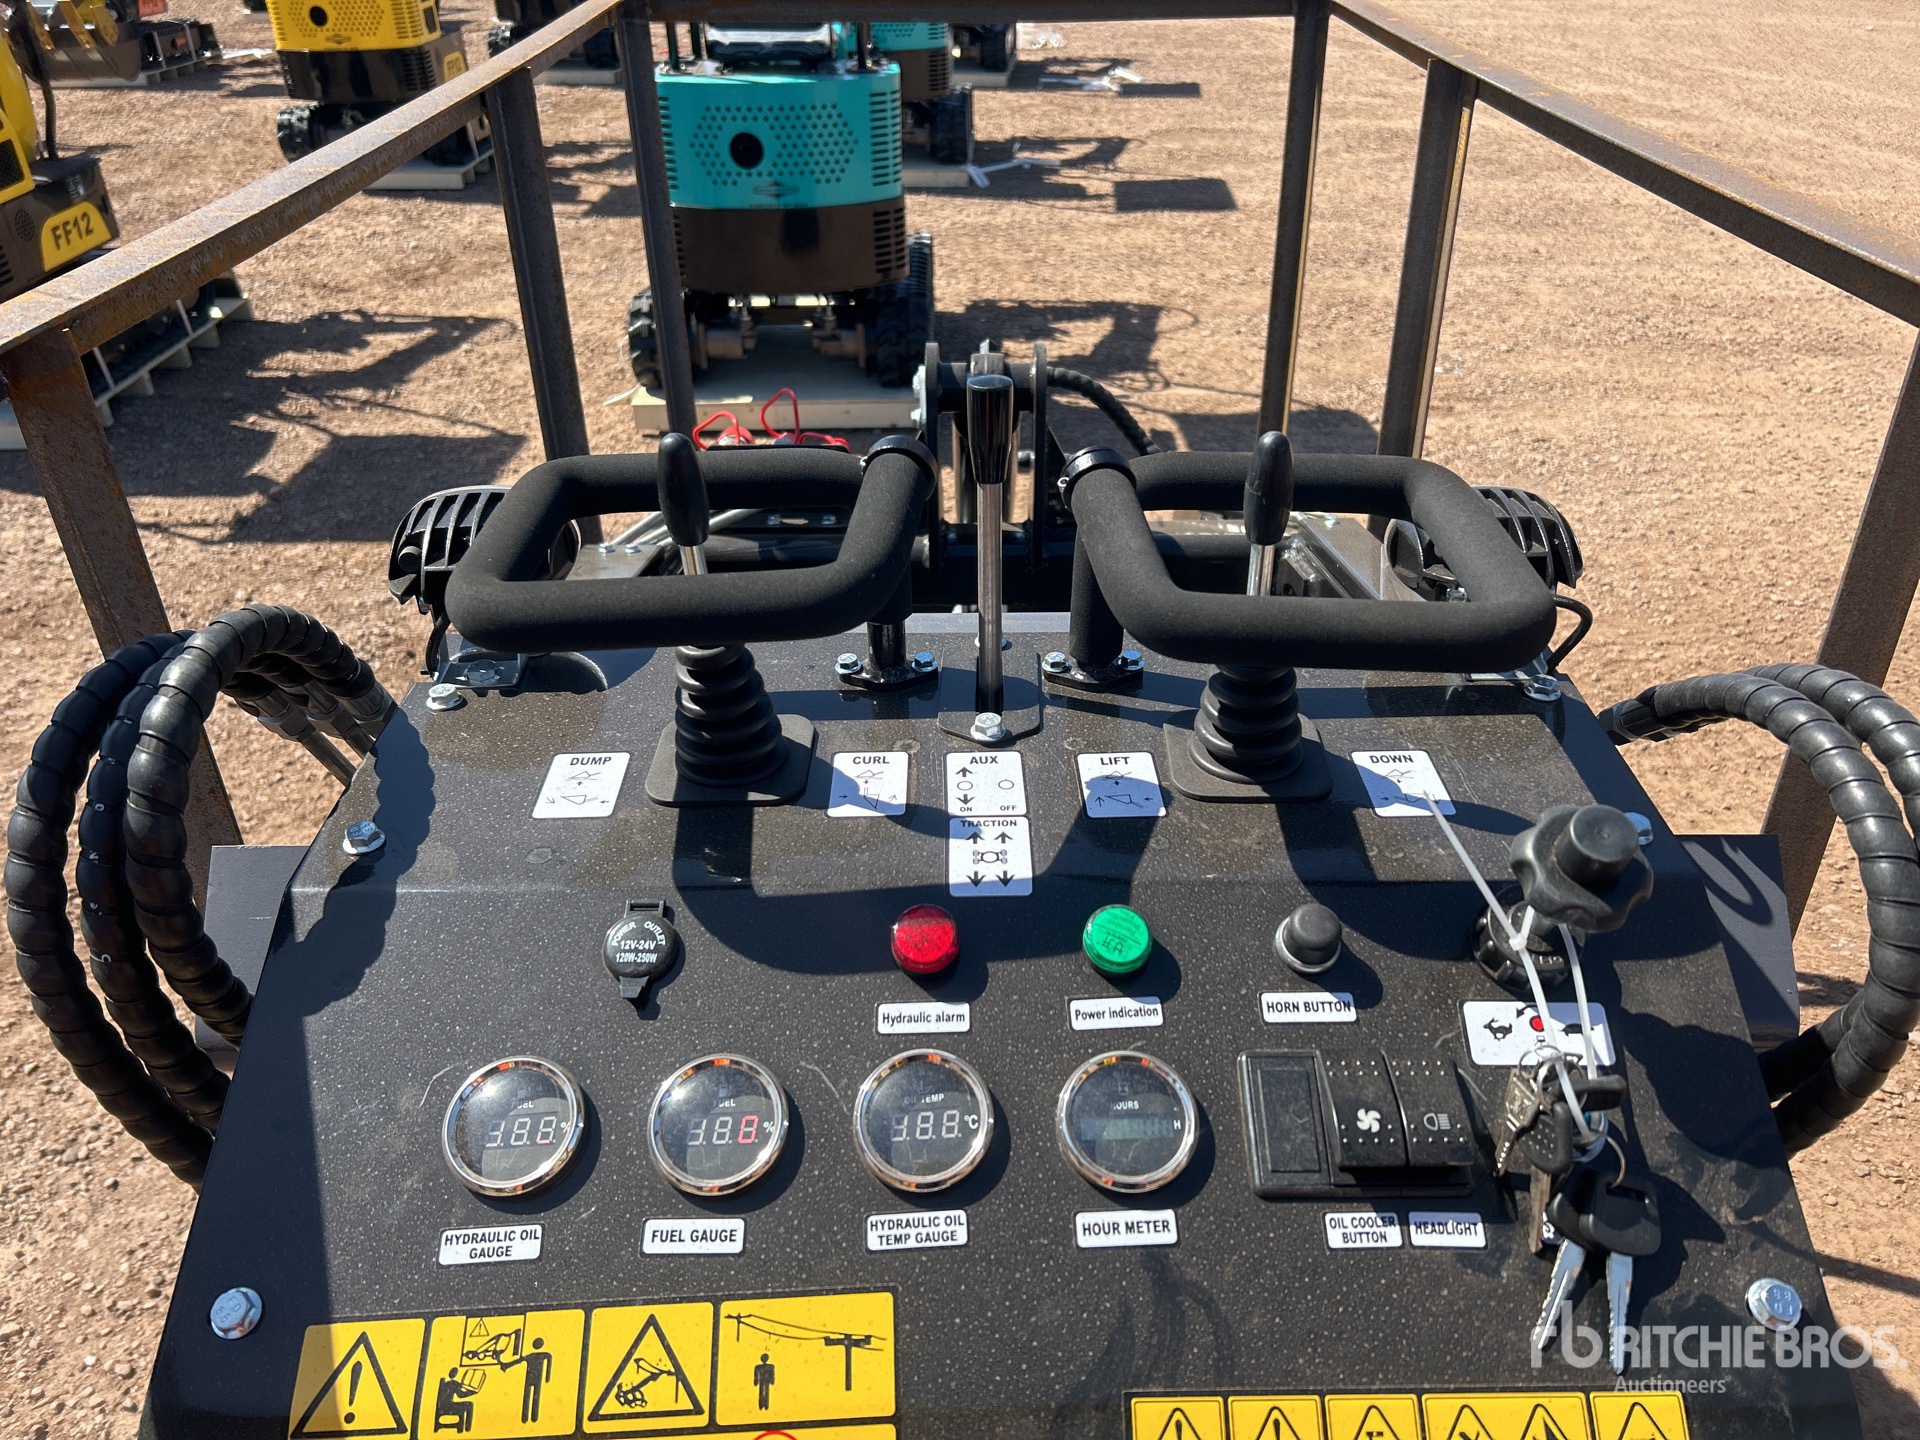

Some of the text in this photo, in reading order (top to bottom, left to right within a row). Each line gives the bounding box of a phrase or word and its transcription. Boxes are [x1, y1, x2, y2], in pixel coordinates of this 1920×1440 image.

[51, 211, 94, 251] FF12
[569, 756, 612, 766] DUMP
[852, 755, 890, 765] CURL
[969, 755, 999, 765] AUX
[1100, 756, 1130, 766] LIFT
[1369, 754, 1414, 764] DOWN
[999, 804, 1017, 812] OFF
[960, 819, 1018, 828] TRACTION
[611, 920, 666, 947] POWER OUTLET
[620, 939, 657, 951] 12V-24V
[615, 952, 658, 964] 120W-250W
[1075, 1005, 1159, 1020] Power indication
[1266, 1001, 1351, 1013] HORN BUTTON
[882, 1010, 965, 1027] Hydraulic alarm
[921, 1093, 945, 1104] TEMP
[1110, 1100, 1140, 1110] HOURS
[870, 1213, 965, 1232] HYDRAULIC OIL
[1082, 1219, 1171, 1236] HOUR METER
[1328, 1216, 1397, 1229] OIL COOLER
[1413, 1220, 1479, 1237] HEADLIGHT
[444, 1228, 540, 1247] HYDRAULIC OIL
[651, 1228, 738, 1243] FUEL GAUGE
[877, 1230, 958, 1247] TEMP GAUGE
[1341, 1231, 1388, 1244] BUTTON
[468, 1245, 514, 1260] GAUGE
